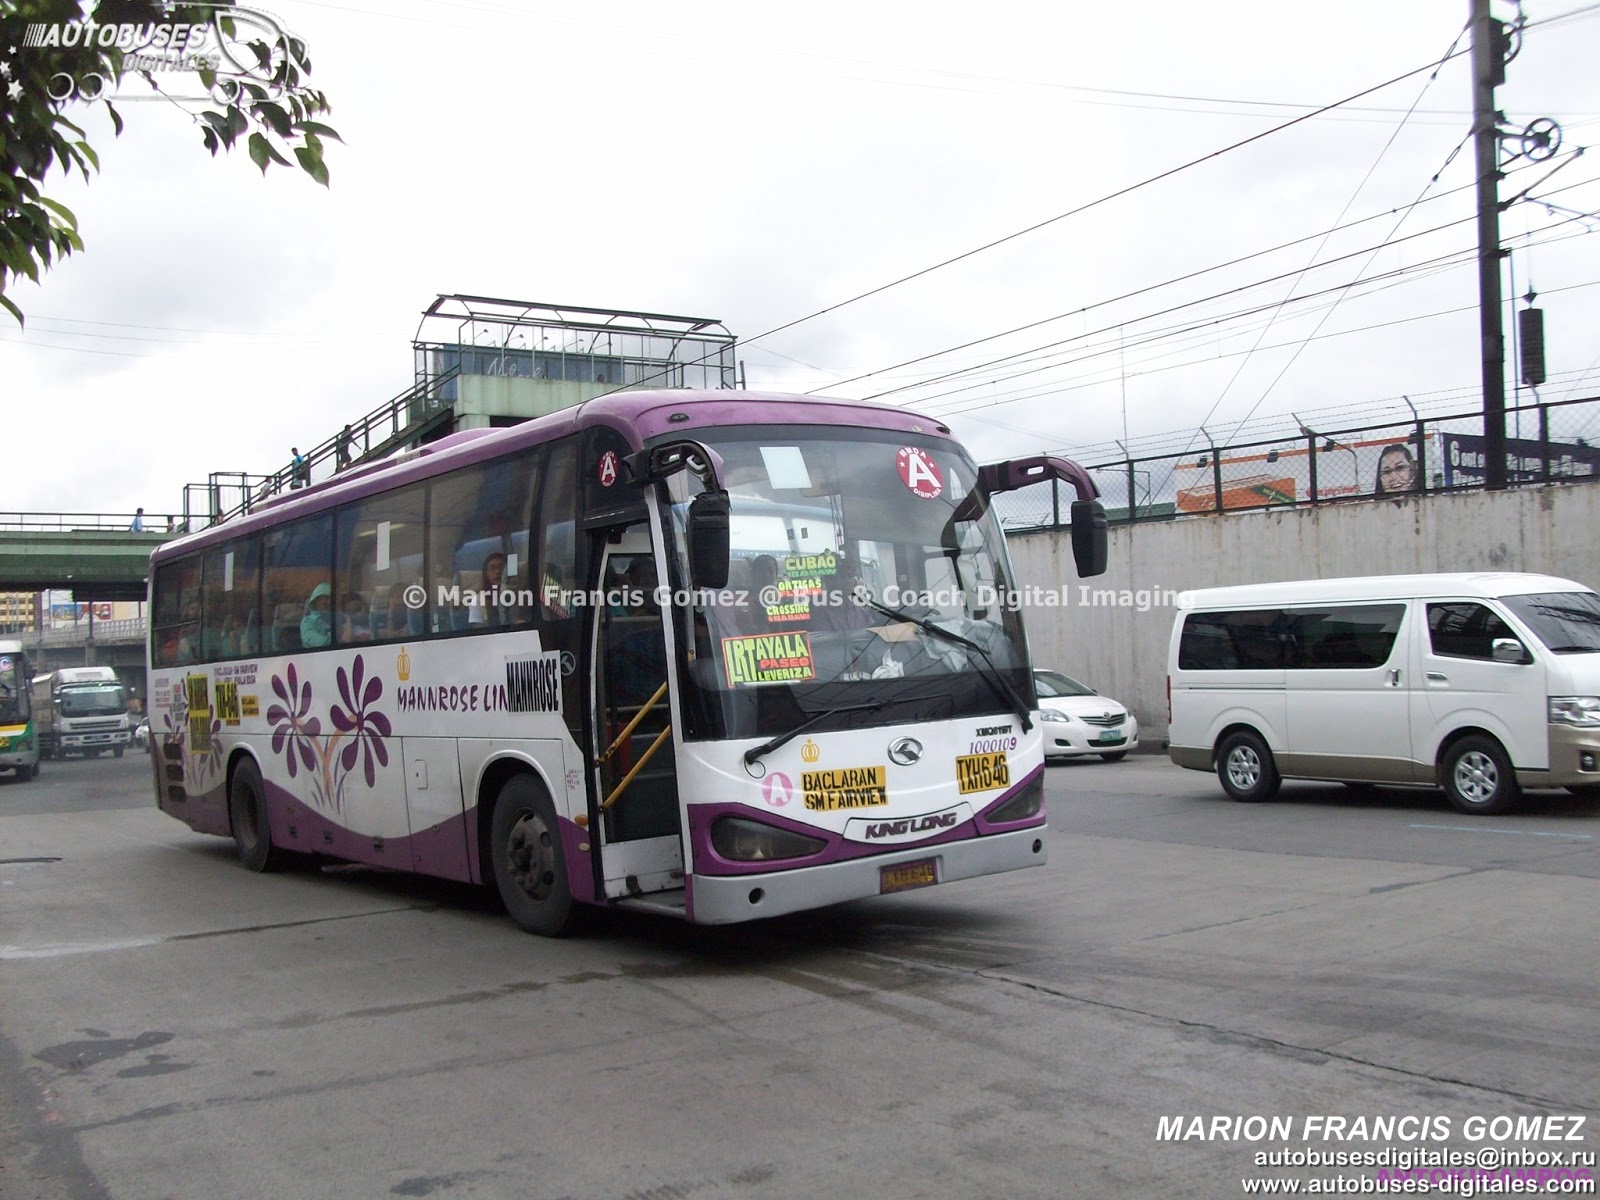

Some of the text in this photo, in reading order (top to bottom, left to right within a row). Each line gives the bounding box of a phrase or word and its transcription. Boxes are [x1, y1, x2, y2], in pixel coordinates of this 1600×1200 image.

[601, 456, 617, 481] A
[909, 453, 942, 488] A
[785, 555, 836, 571] CUBAO
[778, 579, 822, 592] ORTIGAS
[766, 604, 810, 616] CROSSING
[756, 633, 809, 660] AYALA
[758, 666, 813, 682] LEVERIZA
[759, 657, 810, 669] PASEO
[506, 658, 559, 713] MANNROSE
[397, 684, 479, 713] MANNROSE
[969, 736, 1017, 755] 1000109
[803, 767, 877, 791] BACLARAN
[829, 785, 888, 808] FAIRVIEW
[865, 812, 957, 839] KING LONG
